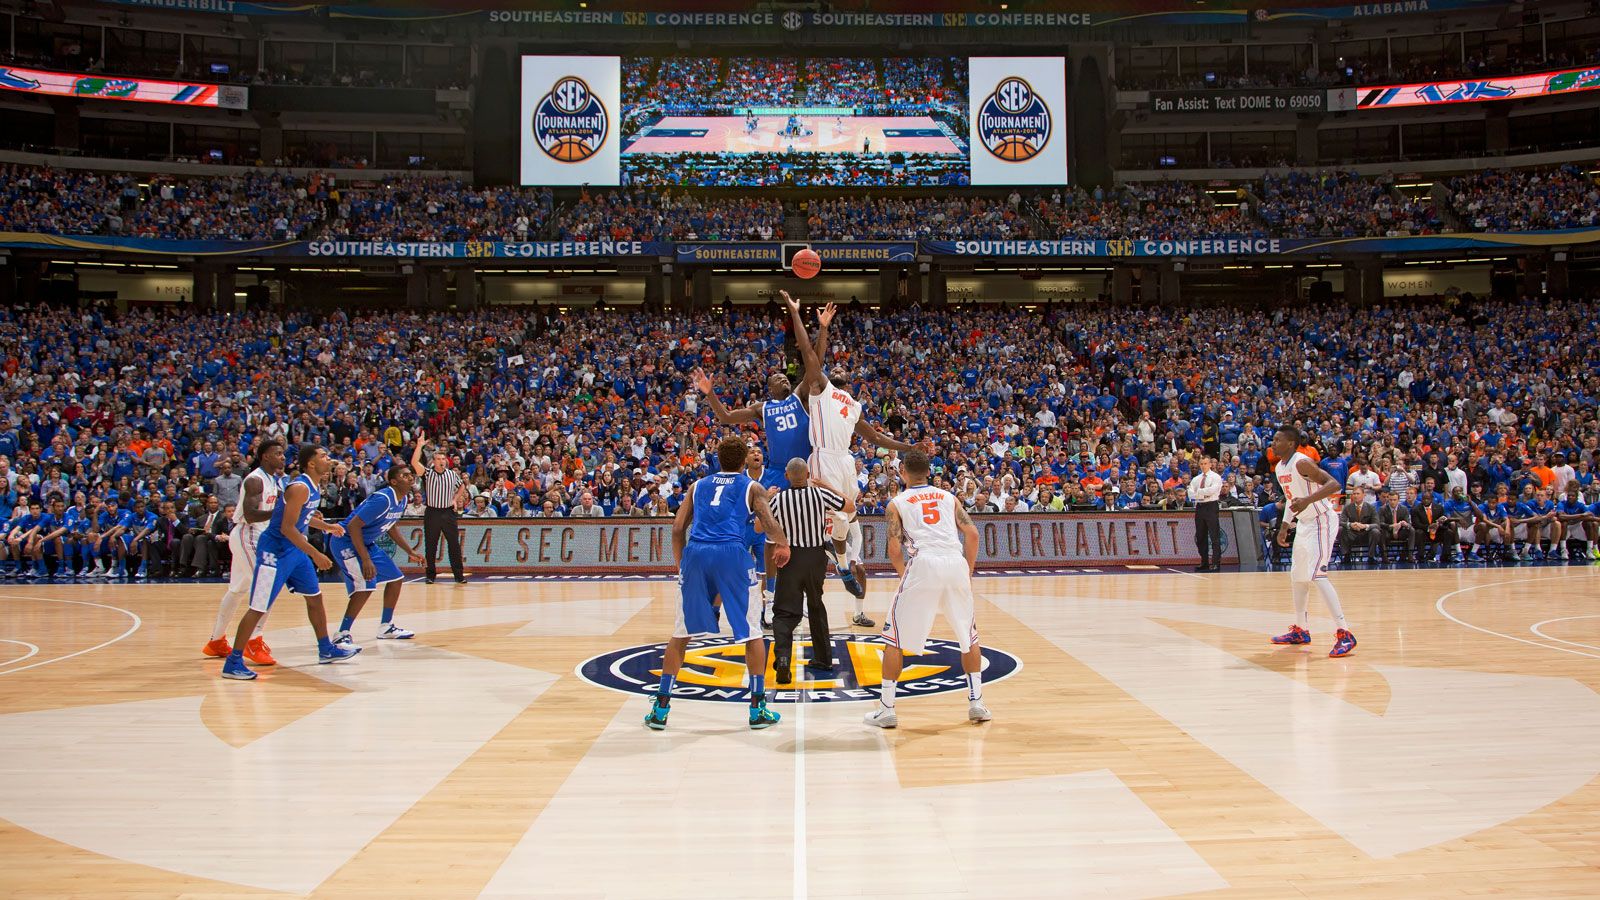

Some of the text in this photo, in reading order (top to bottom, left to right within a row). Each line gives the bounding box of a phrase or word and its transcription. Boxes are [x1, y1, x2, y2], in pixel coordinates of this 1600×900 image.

[1353, 0, 1429, 16] ALABAMA
[489, 11, 773, 25] SOUTHEASTERN SEC CONFERENCE
[782, 12, 801, 29] SEC
[812, 13, 1091, 27] SOUTHEASTERN SEC CONFERENCE
[557, 81, 585, 111] SEC
[1000, 81, 1028, 111] SEC
[1155, 95, 1321, 110] Fan Assist: Text DOME to 69050
[538, 113, 603, 130] TOURNAMENT
[984, 113, 1046, 130] TOURNAMENT
[308, 240, 642, 258] SOUTHEASTERN SEC CONFERENCE
[695, 249, 890, 260] SOUTHEASTERN CONFERENCE
[955, 239, 1281, 257] SOUTHEASTERN SEC CONFERENCE
[165, 286, 190, 294] MEN
[1388, 280, 1433, 289] WOMEN
[767, 401, 798, 416] KENTUCKY
[840, 406, 849, 419] 4
[775, 413, 798, 432] 30
[711, 476, 736, 485] YOUNG
[710, 485, 725, 506] 1
[906, 492, 945, 505] WILBEKIN
[921, 501, 941, 524] 5
[516, 527, 575, 563] SEC
[984, 520, 1180, 557] OURNAMENT
[648, 641, 951, 690] SEC
